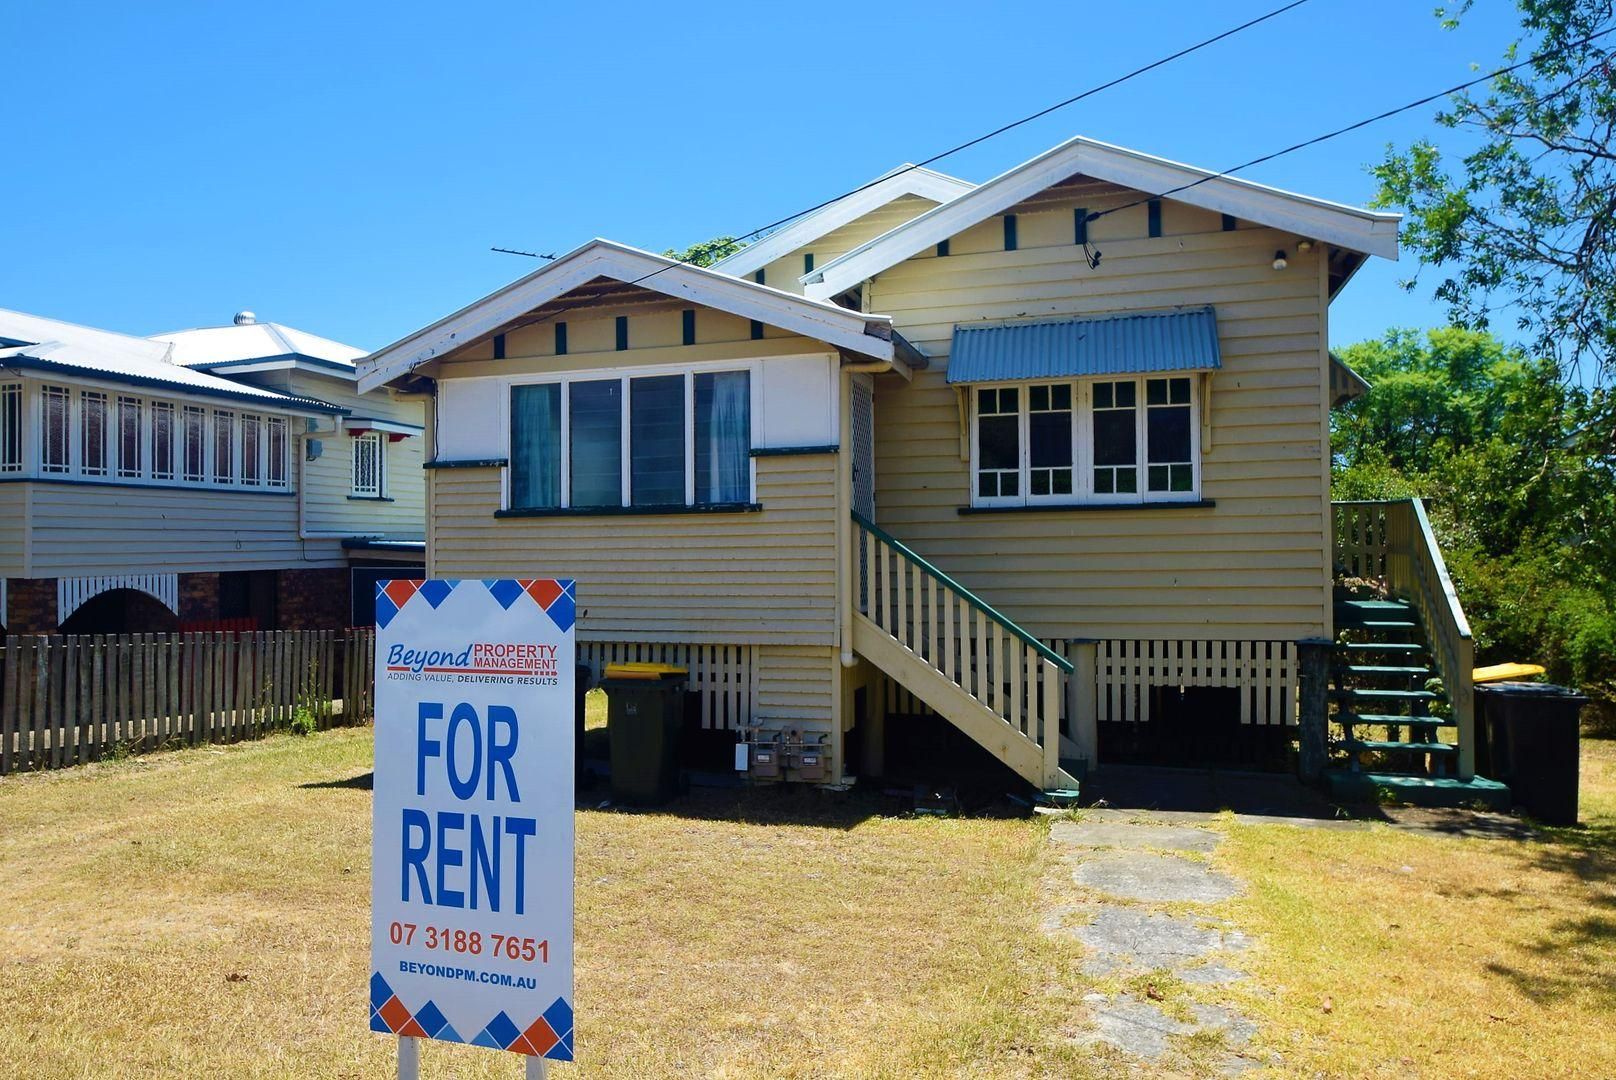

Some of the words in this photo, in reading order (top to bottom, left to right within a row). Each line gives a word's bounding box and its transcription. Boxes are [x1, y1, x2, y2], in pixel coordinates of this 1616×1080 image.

[387, 643, 473, 673] Beyond
[474, 643, 558, 658] PROPERTY
[473, 657, 558, 669] MANAGEMENT
[387, 672, 422, 682] ADDING
[423, 674, 455, 683] VALUE,
[457, 675, 514, 685] DELIVERING
[517, 677, 558, 686] RESULTS
[417, 702, 521, 803] FOR
[401, 808, 536, 915] RENT
[389, 921, 417, 945] 07
[425, 926, 482, 955] 3188
[490, 934, 549, 963] 7651
[399, 960, 537, 990] BEYONDPM.COM.AU
